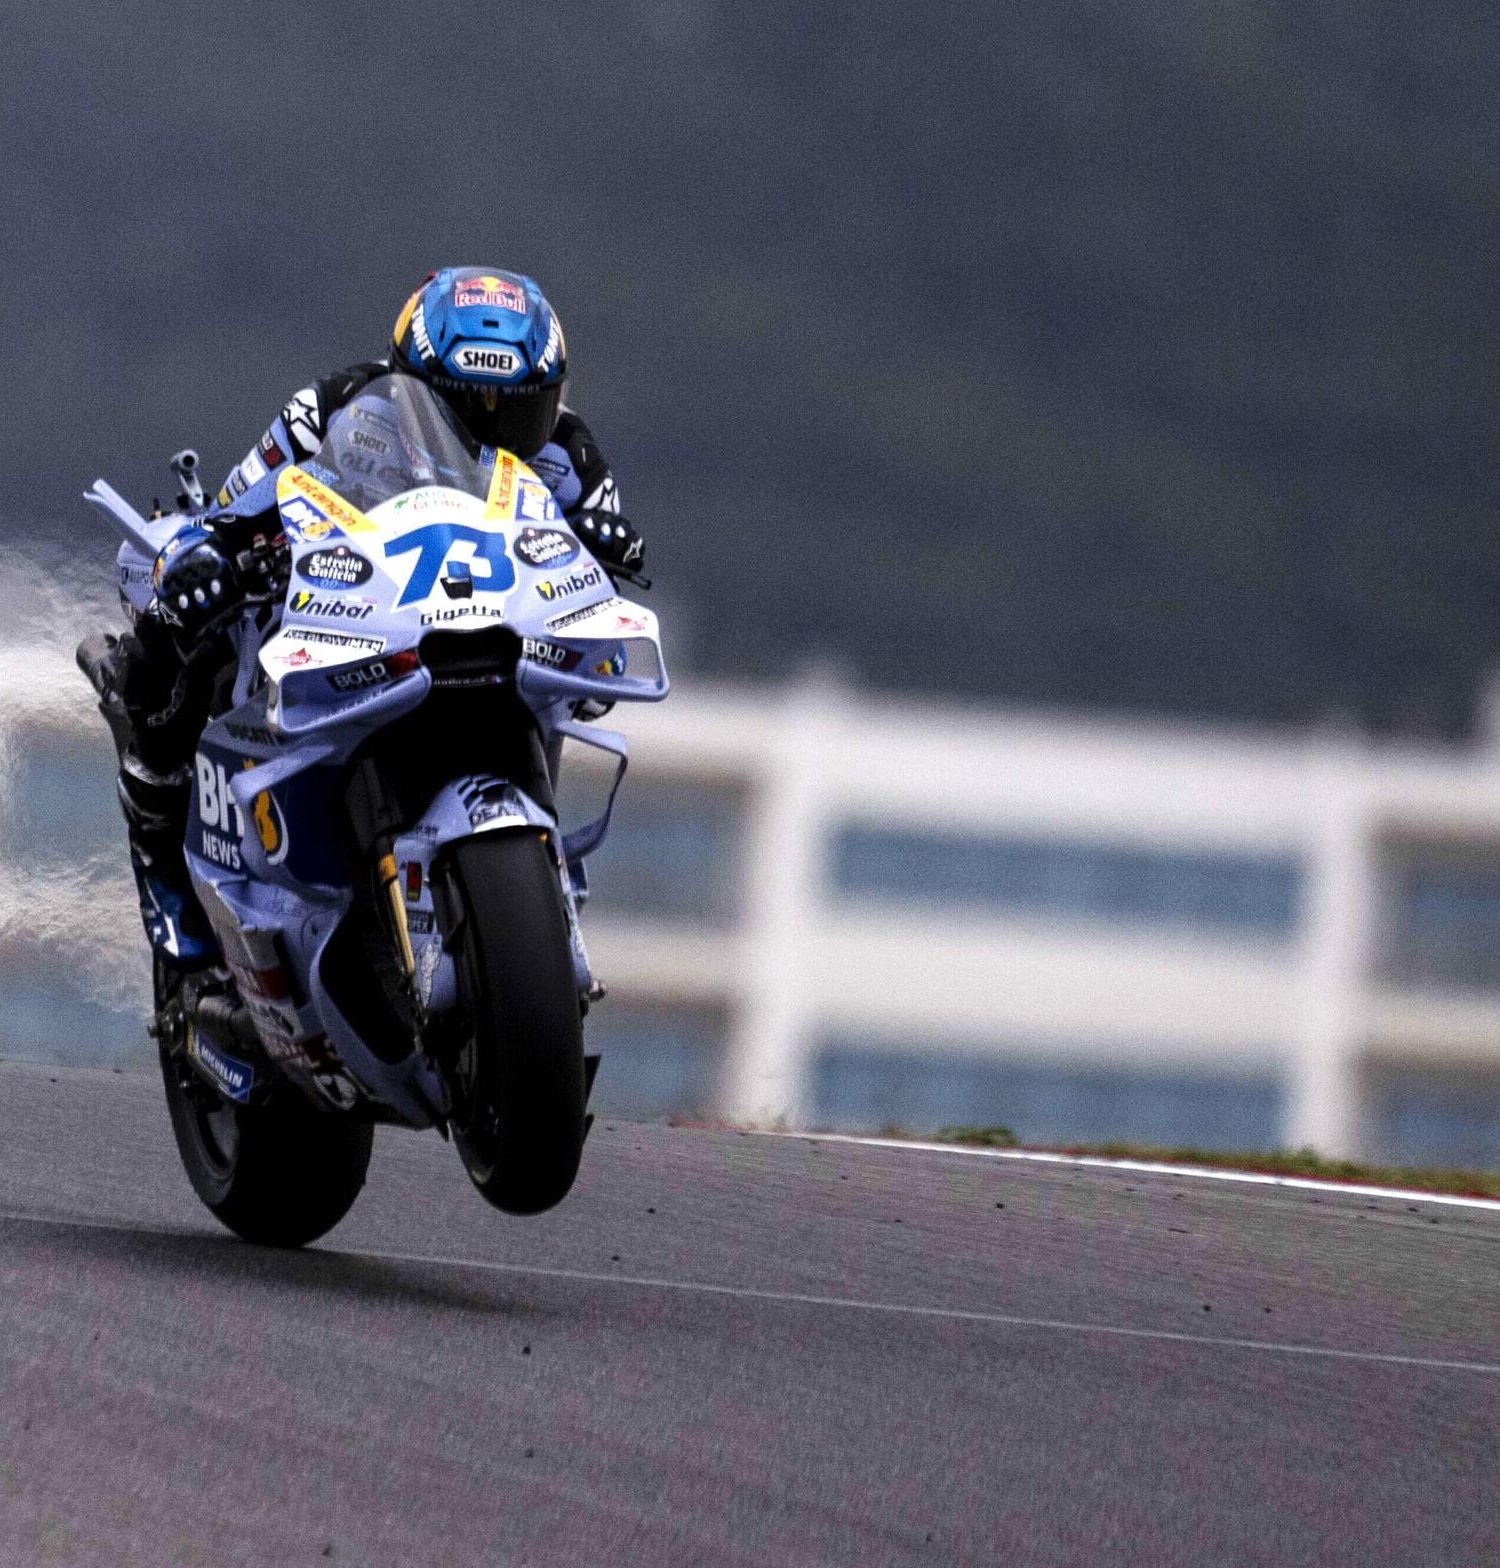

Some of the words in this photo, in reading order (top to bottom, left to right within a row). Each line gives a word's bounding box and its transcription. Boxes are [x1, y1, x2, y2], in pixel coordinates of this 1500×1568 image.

[455, 292, 491, 308] Red
[493, 293, 526, 315] Bull
[462, 350, 513, 371] SHOEI
[308, 566, 357, 583] Galicia
[311, 553, 364, 573] Estrella
[383, 523, 516, 609] 73
[536, 566, 602, 602] Unibat
[289, 592, 374, 619] Unibat
[420, 605, 502, 625] Gigetta
[522, 638, 566, 662] BOLD
[332, 661, 387, 689] BOLD
[202, 829, 241, 870] NEWS
[199, 1042, 244, 1089] MICHELIN
